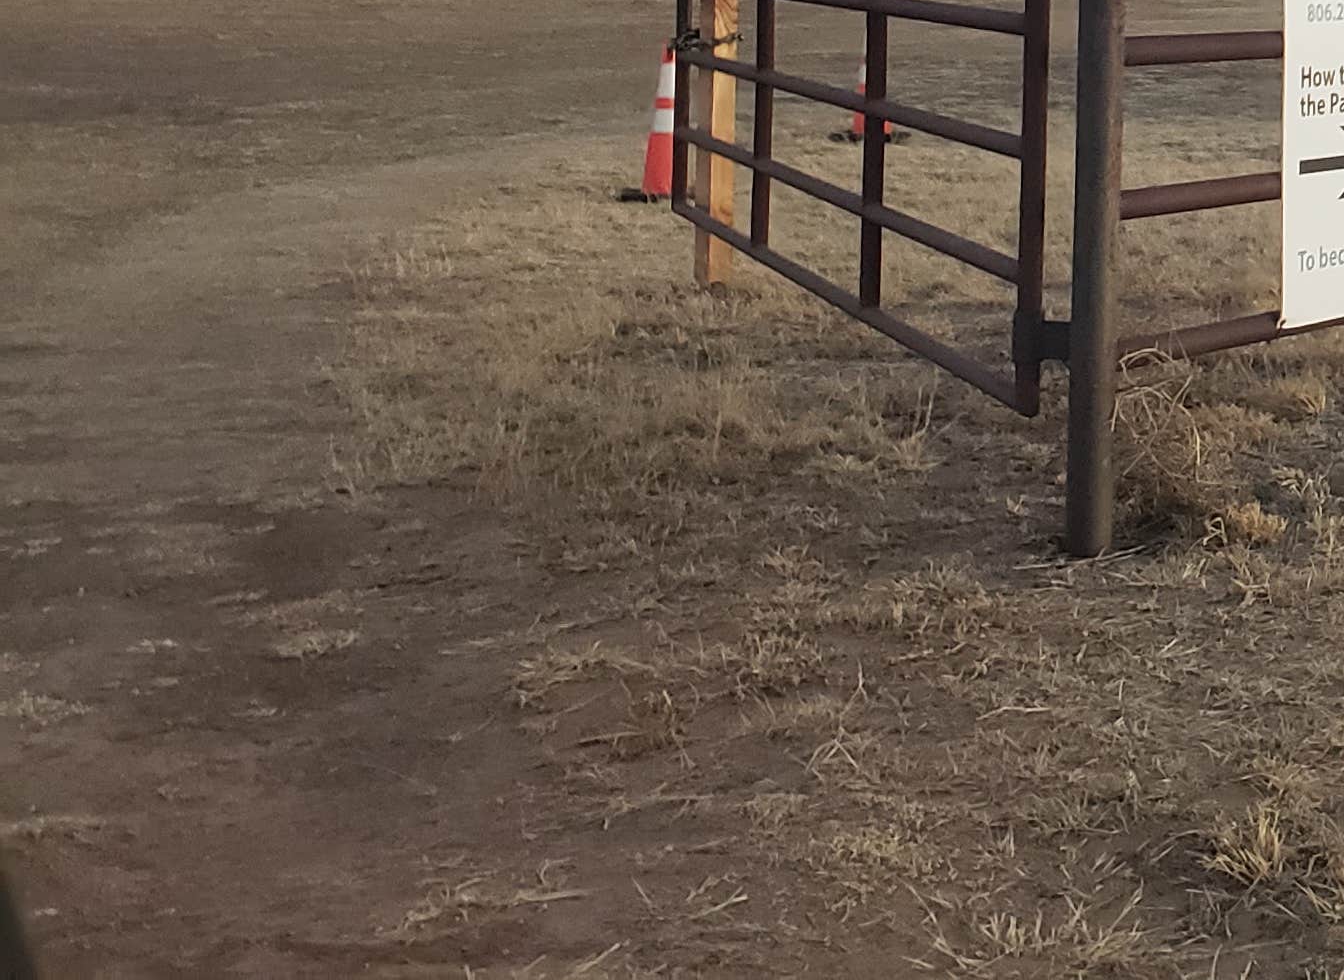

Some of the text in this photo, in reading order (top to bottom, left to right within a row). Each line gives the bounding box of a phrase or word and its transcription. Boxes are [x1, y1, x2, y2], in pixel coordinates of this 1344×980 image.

[1301, 65, 1335, 89] How
[1300, 93, 1325, 117] the
[1298, 250, 1315, 272] To
